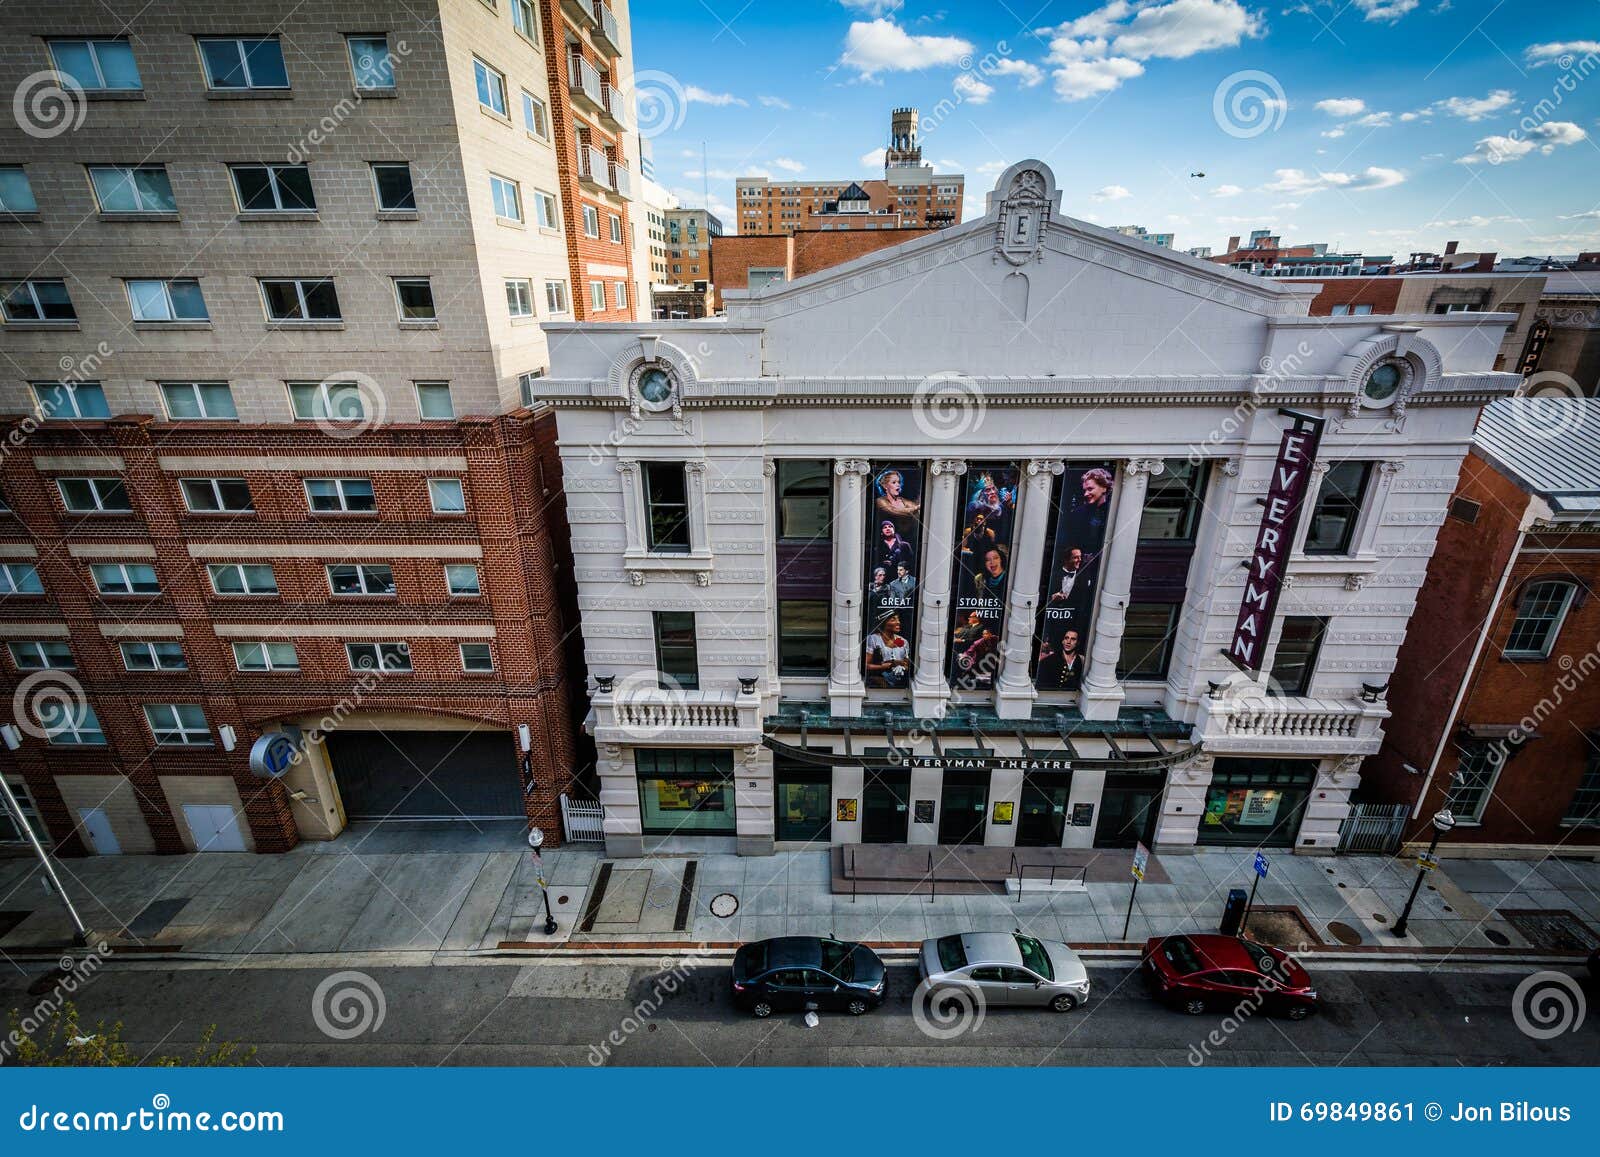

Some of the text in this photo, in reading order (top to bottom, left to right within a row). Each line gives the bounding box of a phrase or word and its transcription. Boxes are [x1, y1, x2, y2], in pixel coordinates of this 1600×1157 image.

[1017, 215, 1028, 235] E
[1234, 435, 1305, 662] EVERYMAN
[881, 597, 912, 606] GREAT
[975, 609, 1073, 619] WELL TOLD.
[902, 758, 1072, 769] EVERYMAN THEATRE
